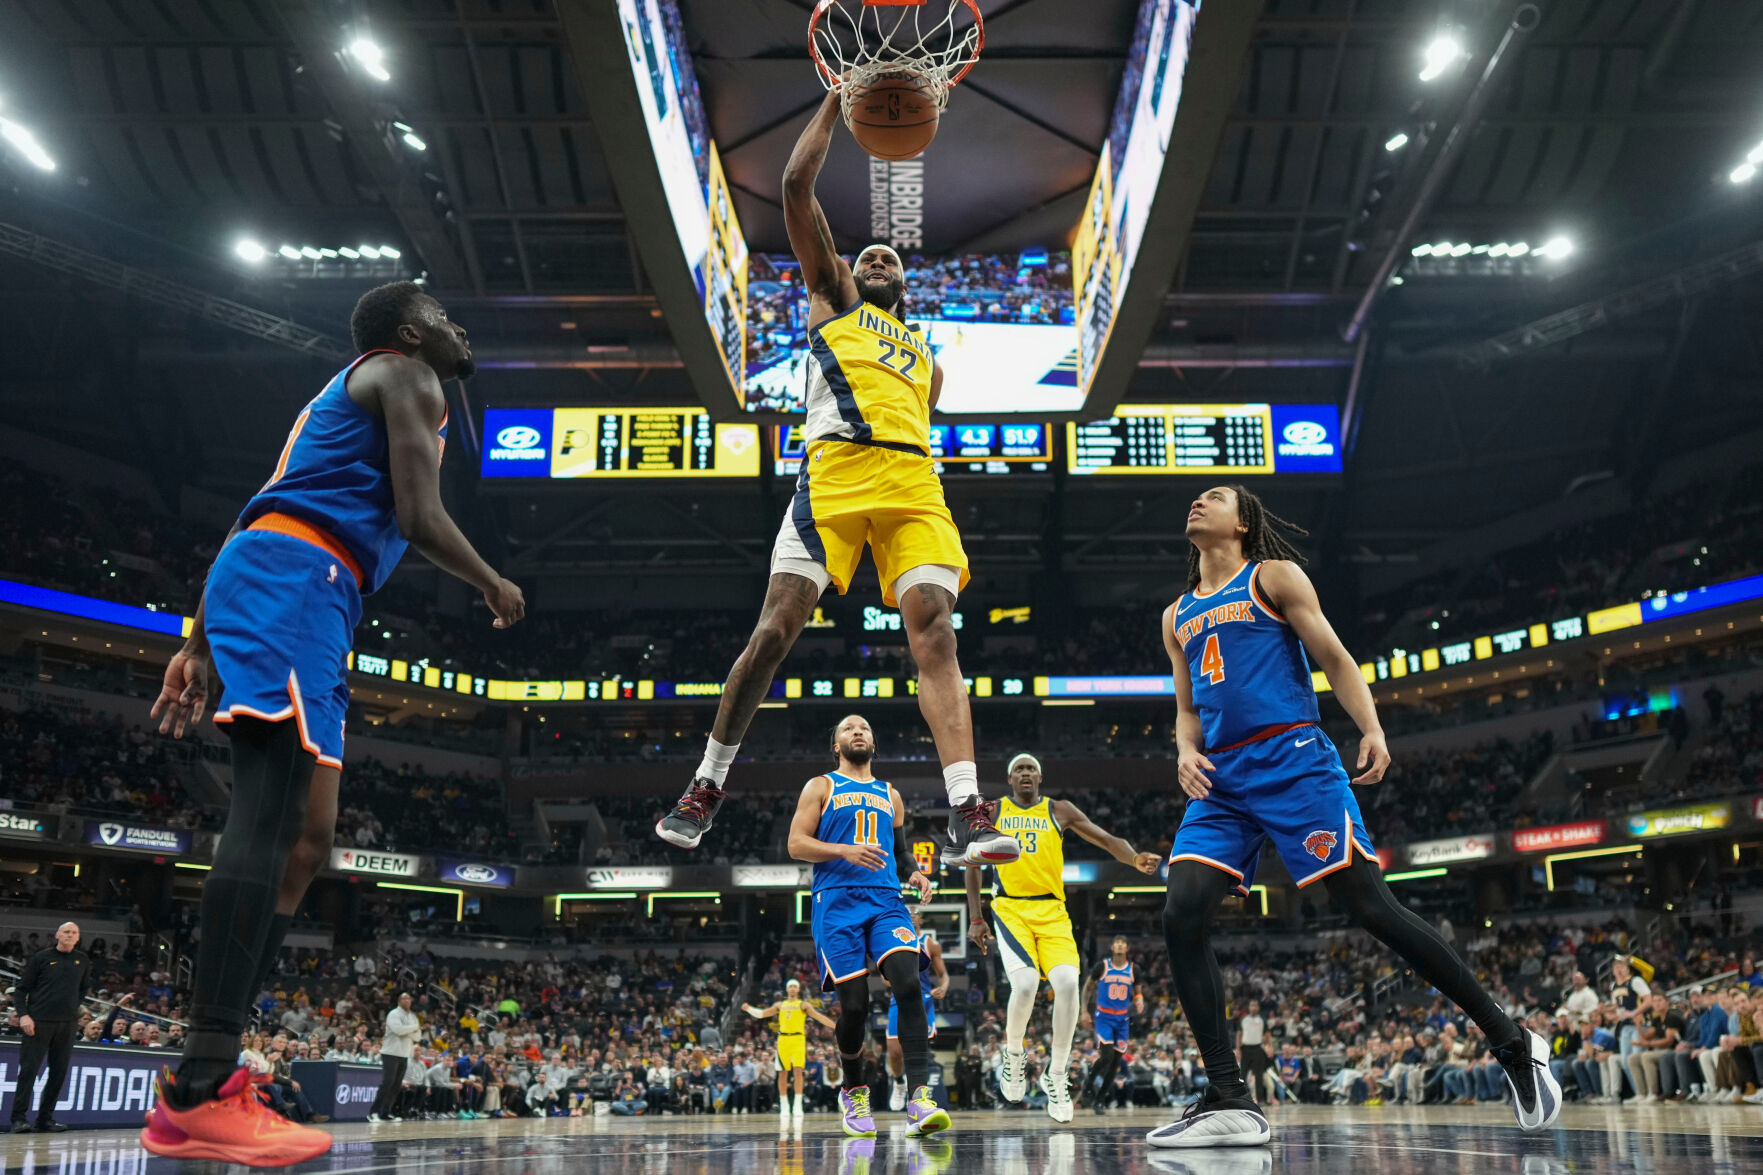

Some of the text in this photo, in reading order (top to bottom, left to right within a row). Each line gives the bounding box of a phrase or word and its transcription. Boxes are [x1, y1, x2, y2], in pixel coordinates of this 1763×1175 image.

[869, 153, 889, 238] ELDHOUSE
[889, 153, 924, 249] INBRIDGE
[878, 338, 917, 382] 22
[961, 429, 990, 446] 4.3
[1004, 428, 1039, 446] 51.9
[863, 606, 901, 631] Sire
[1177, 600, 1256, 647] NEW YORK
[1201, 633, 1225, 685] 4
[832, 792, 893, 818] NEW YORK
[126, 827, 179, 842] FANDUEL
[854, 809, 879, 845] 11
[1000, 816, 1049, 831] INDIANA
[1514, 832, 1552, 848] STEAK
[1562, 823, 1603, 841] SHAKE
[355, 854, 409, 873] DEEM
[462, 865, 490, 880] Ford
[1108, 983, 1128, 1000] 00
[351, 1086, 379, 1103] HYUN
